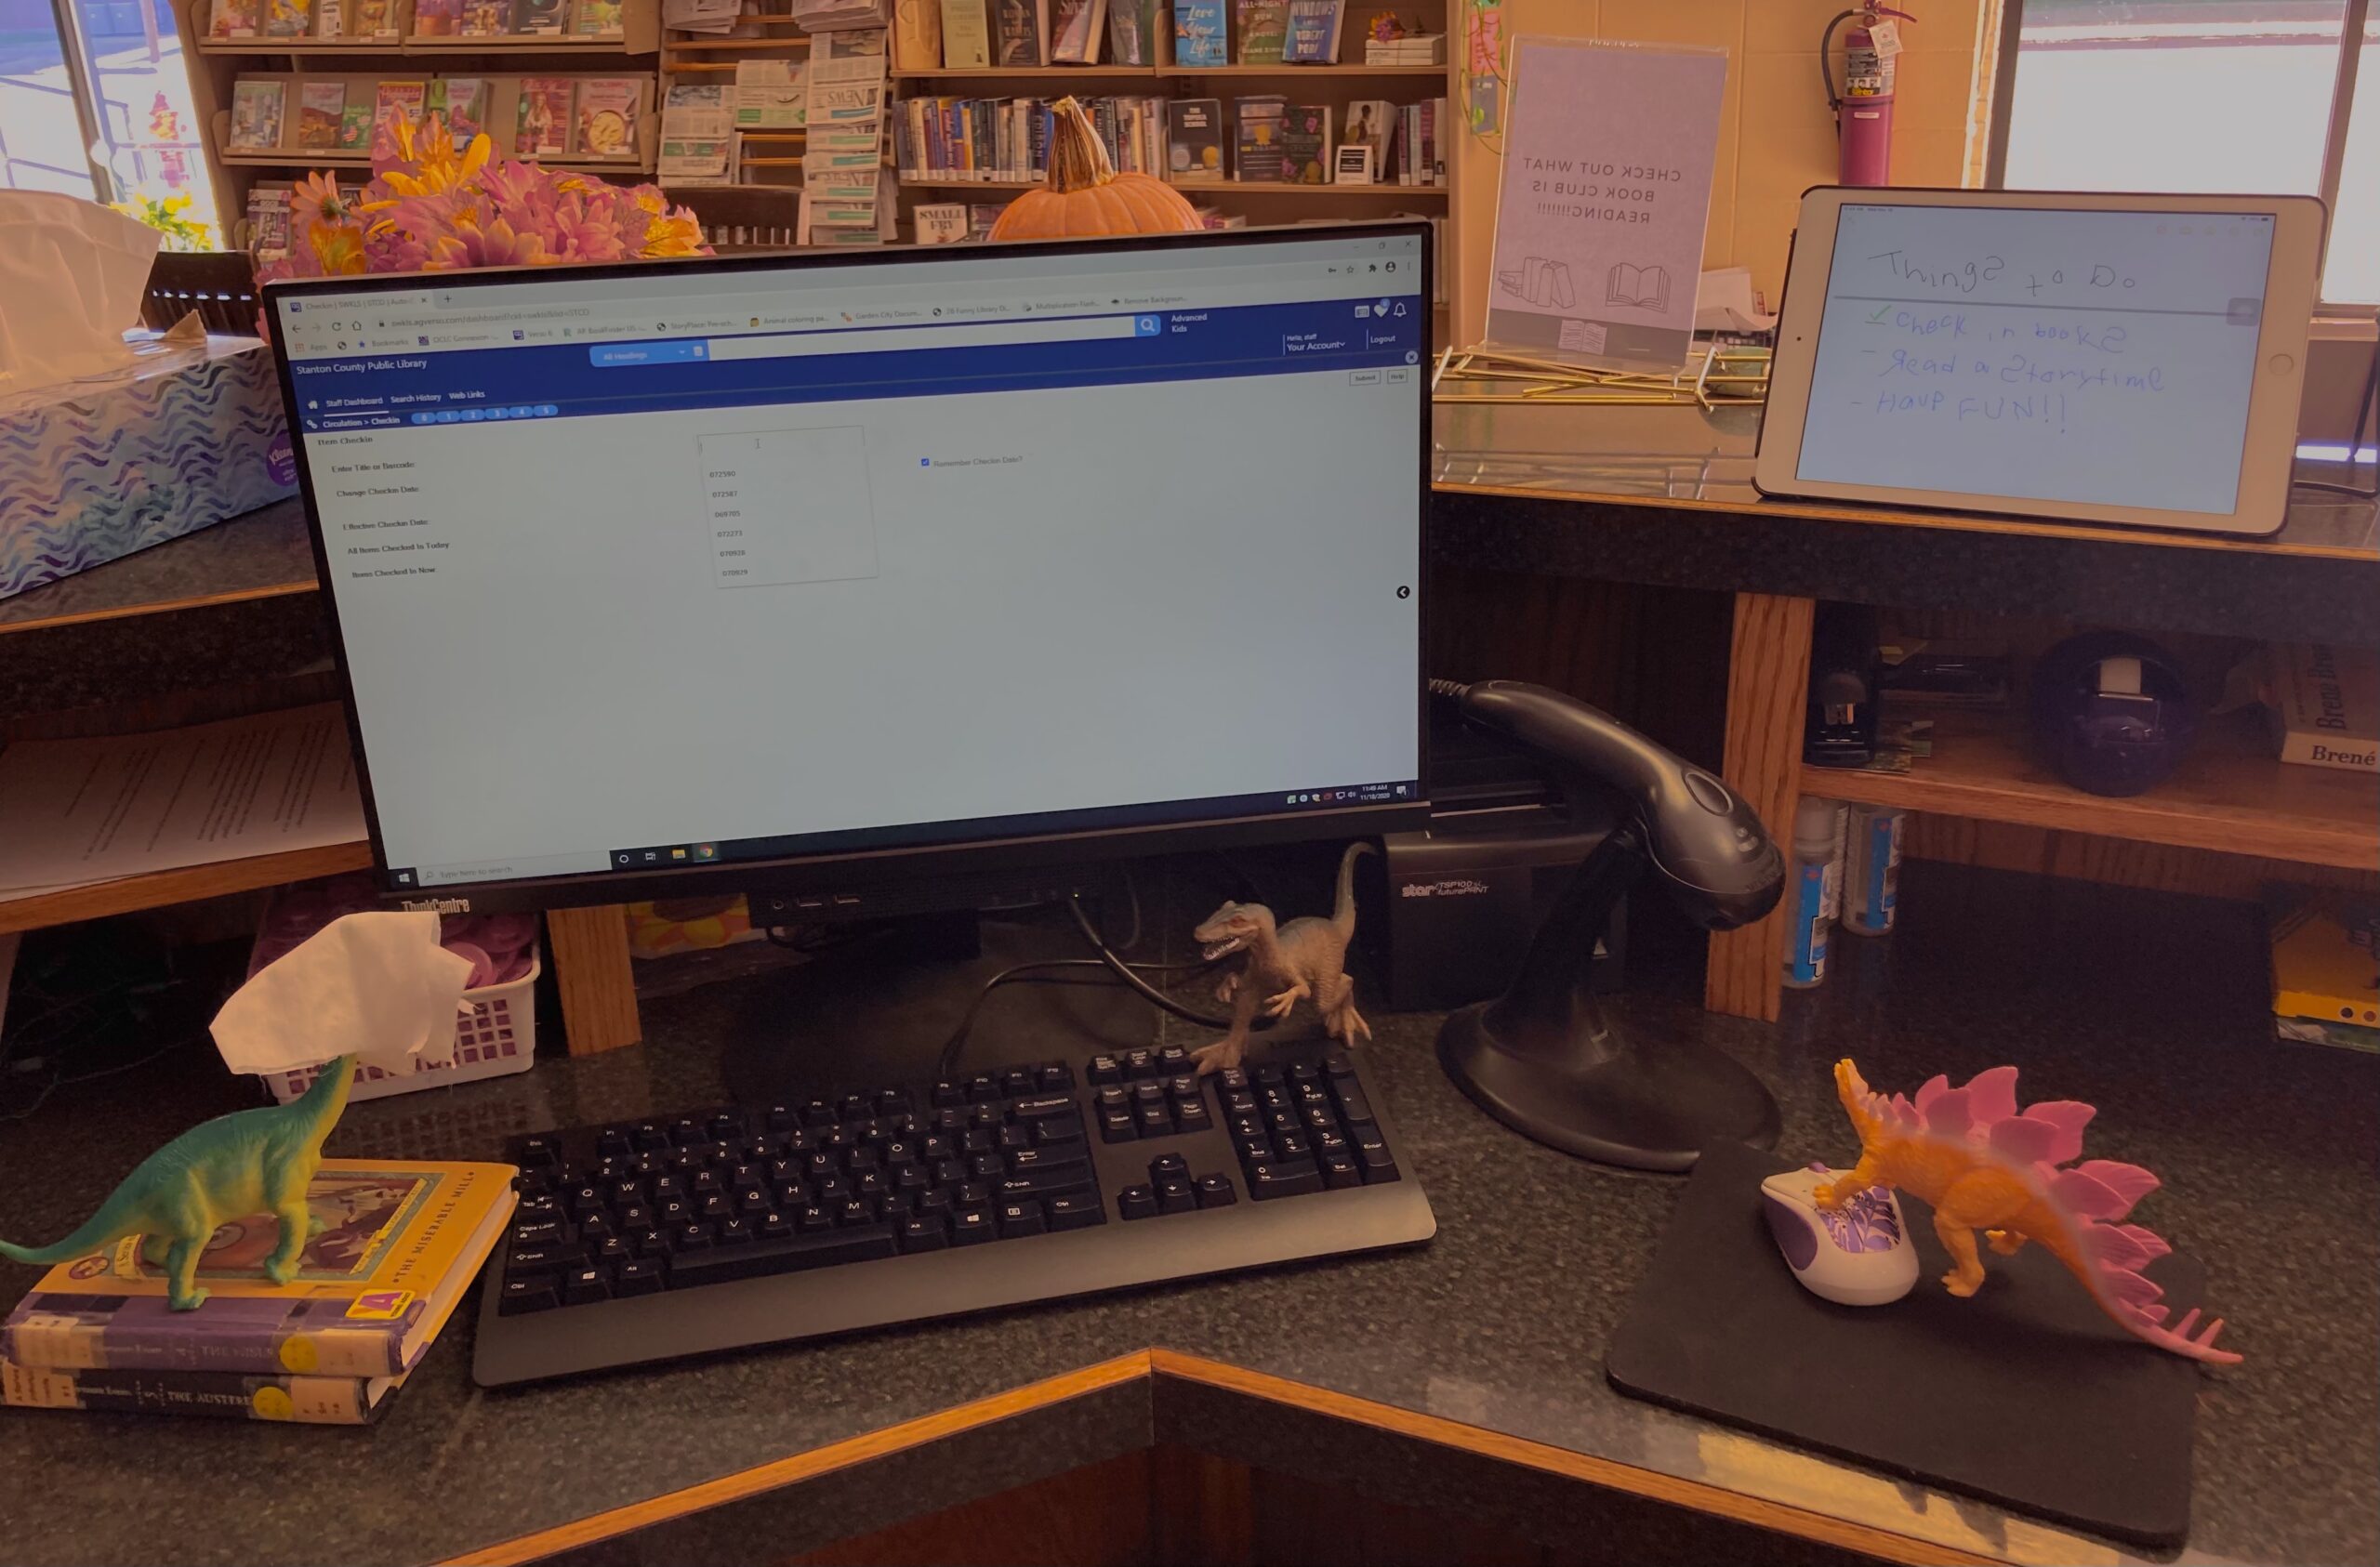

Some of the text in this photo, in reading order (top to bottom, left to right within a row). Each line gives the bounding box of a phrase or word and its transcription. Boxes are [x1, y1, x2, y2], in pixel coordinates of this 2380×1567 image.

[1187, 6, 1215, 20] Love
[1187, 22, 1216, 40] Your
[1190, 41, 1210, 58] Life
[826, 88, 867, 106] NEWS
[919, 209, 962, 219] SMALL
[931, 220, 953, 230] FRY
[1868, 250, 2136, 296] Things to Do
[1170, 312, 1209, 323] Advanced
[372, 337, 409, 348] Bookmarks
[855, 311, 879, 321] Garden
[1171, 324, 1188, 334] Kids
[1896, 309, 1967, 336] Check
[2035, 323, 2127, 353] books
[1370, 335, 1396, 346] Logout
[1287, 340, 1341, 352] Your Account
[297, 359, 429, 375] Stanton County Public Library
[1975, 361, 1990, 375] a
[2000, 354, 2165, 392] Storytime
[325, 388, 486, 408] Staff Dashboard Search History Web Links
[322, 415, 401, 429] Circulation Checkin
[339, 436, 374, 445] Checkin
[972, 456, 1001, 466] Checkin
[331, 465, 353, 474] Enter
[354, 464, 373, 473] Title
[336, 488, 366, 499] Change
[367, 486, 400, 495] Checkin
[342, 521, 377, 532] Effective
[377, 519, 409, 529] Checkin
[381, 543, 416, 554] Checked
[374, 568, 408, 578] Checked
[2311, 745, 2377, 766] Brené
[487, 866, 513, 876] search
[1402, 883, 1433, 898] star
[401, 897, 471, 915] ThinkCentre
[1033, 1098, 1069, 1107] Backspace
[892, 1144, 903, 1152] O
[1363, 1142, 1382, 1151] Enter
[815, 1155, 826, 1164] U
[777, 1161, 787, 1169] Y
[700, 1172, 710, 1180] R
[622, 1182, 636, 1192] W
[660, 1178, 670, 1187] E
[582, 1189, 593, 1197] Q
[788, 1186, 799, 1194] H
[708, 1197, 719, 1205] F
[748, 1192, 760, 1200] G
[669, 1203, 680, 1211] D
[848, 1202, 860, 1210] M
[588, 1215, 600, 1223] A
[769, 1214, 778, 1222] B
[397, 1177, 474, 1277] THE MISERABLE MILL
[648, 1231, 657, 1241] X
[607, 1238, 617, 1246] Z
[167, 1390, 194, 1404] THE
